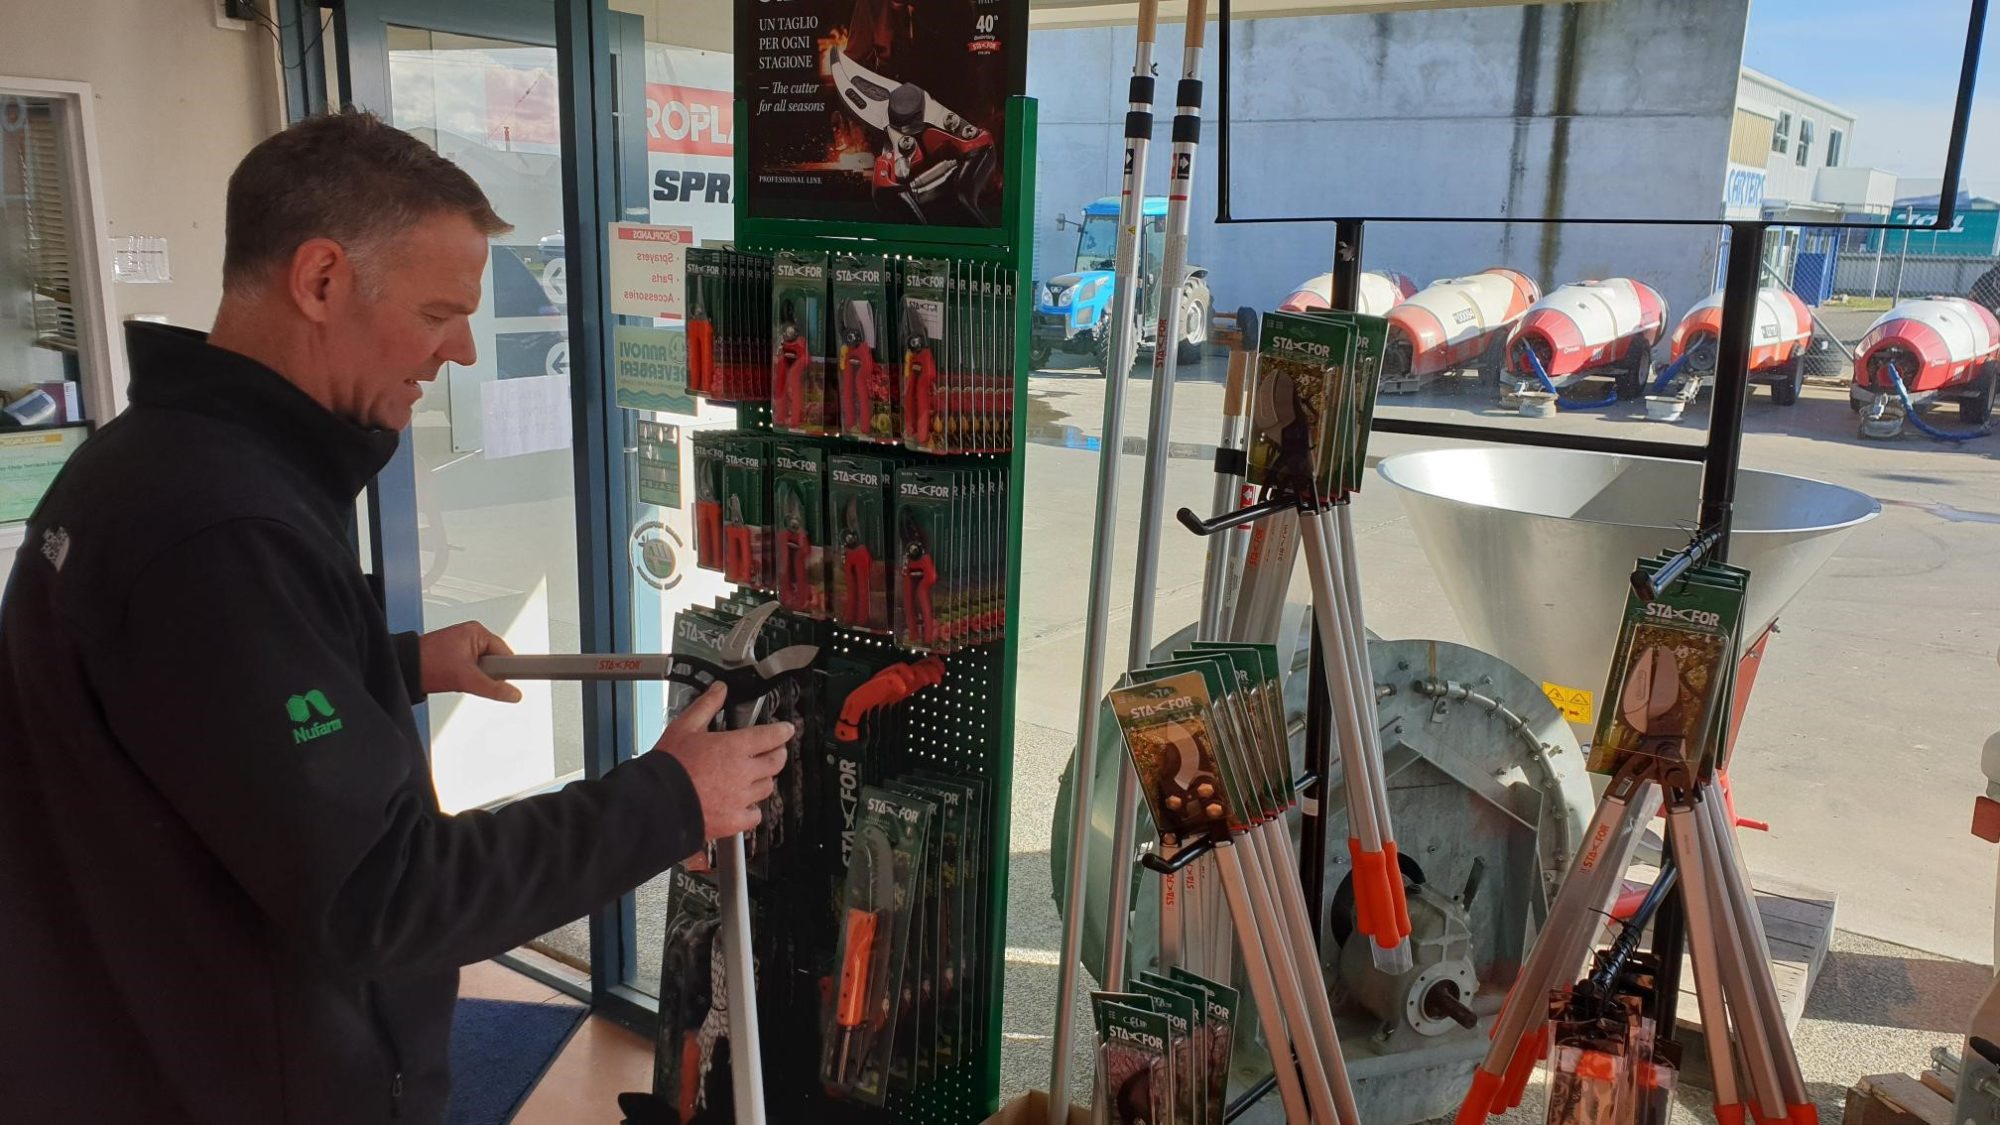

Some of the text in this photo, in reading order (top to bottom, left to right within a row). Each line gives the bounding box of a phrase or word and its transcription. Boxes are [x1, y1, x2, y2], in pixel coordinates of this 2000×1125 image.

[759, 15, 819, 31] UN TAGLIO
[759, 35, 810, 50] PER OGNI
[759, 55, 813, 69] STAGIONE
[772, 81, 789, 94] The
[790, 82, 820, 94] cutter
[756, 99, 825, 116] for all seasons
[646, 98, 734, 145] ROPL
[653, 169, 734, 204] SPR
[806, 176, 822, 185] LINE
[1896, 213, 1964, 233] TOL
[292, 718, 342, 744] Nufarm
